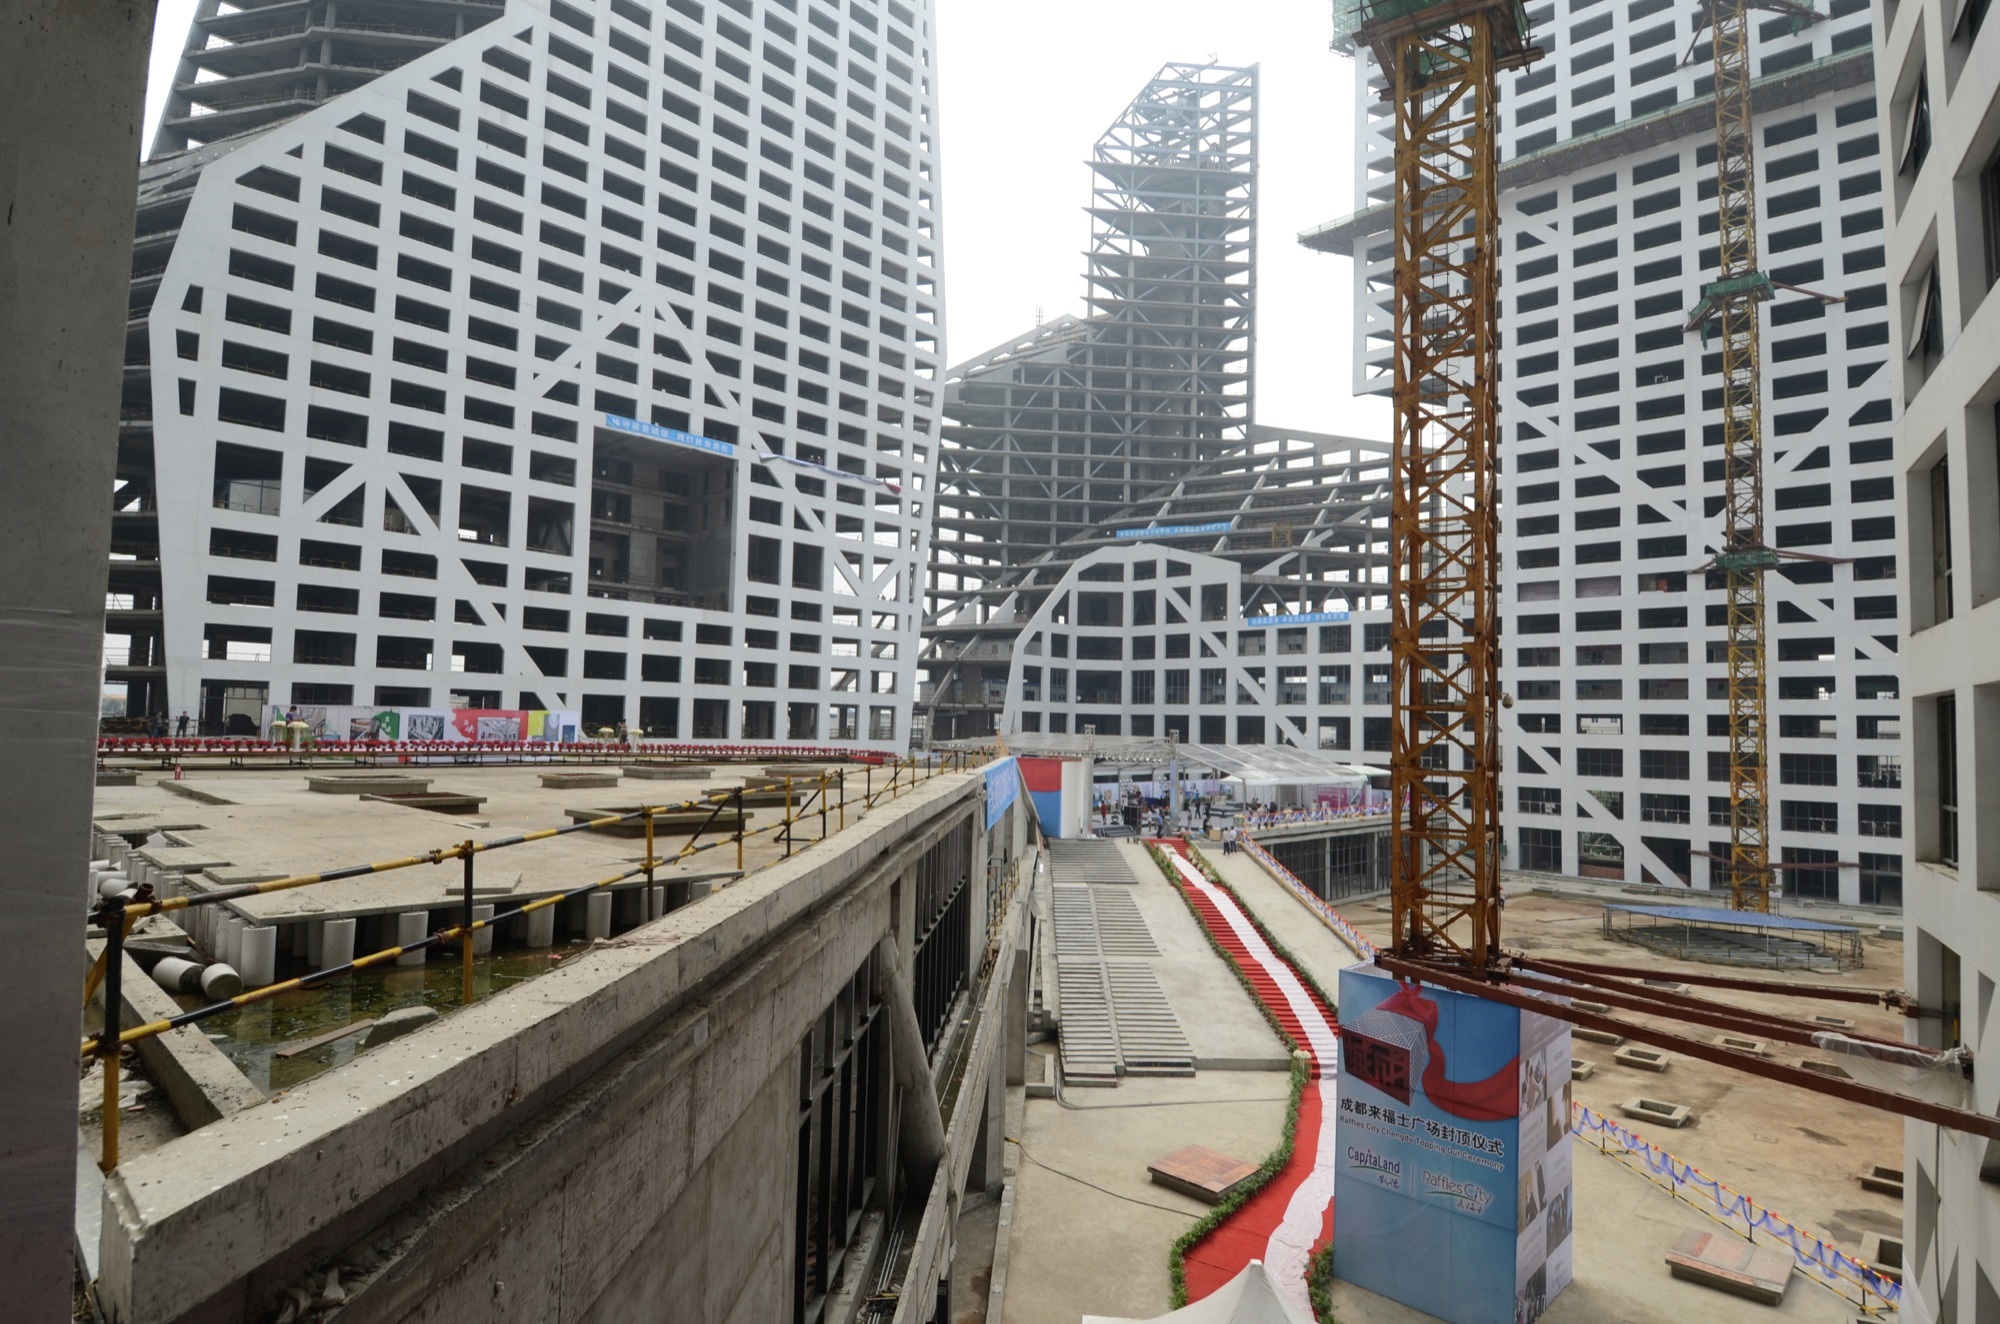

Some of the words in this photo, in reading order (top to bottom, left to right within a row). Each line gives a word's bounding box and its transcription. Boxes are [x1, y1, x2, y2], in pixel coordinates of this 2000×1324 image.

[1340, 1098, 1504, 1156] 成都来福士广场封顶仪式
[1340, 1115, 1364, 1128] Raffles
[1366, 1121, 1380, 1134] City
[1381, 1127, 1414, 1143] Chengdu
[1416, 1137, 1445, 1154] Topping
[1448, 1147, 1461, 1157] Out
[1462, 1152, 1504, 1172] Ceremony
[1347, 1146, 1400, 1173] CapitaLand
